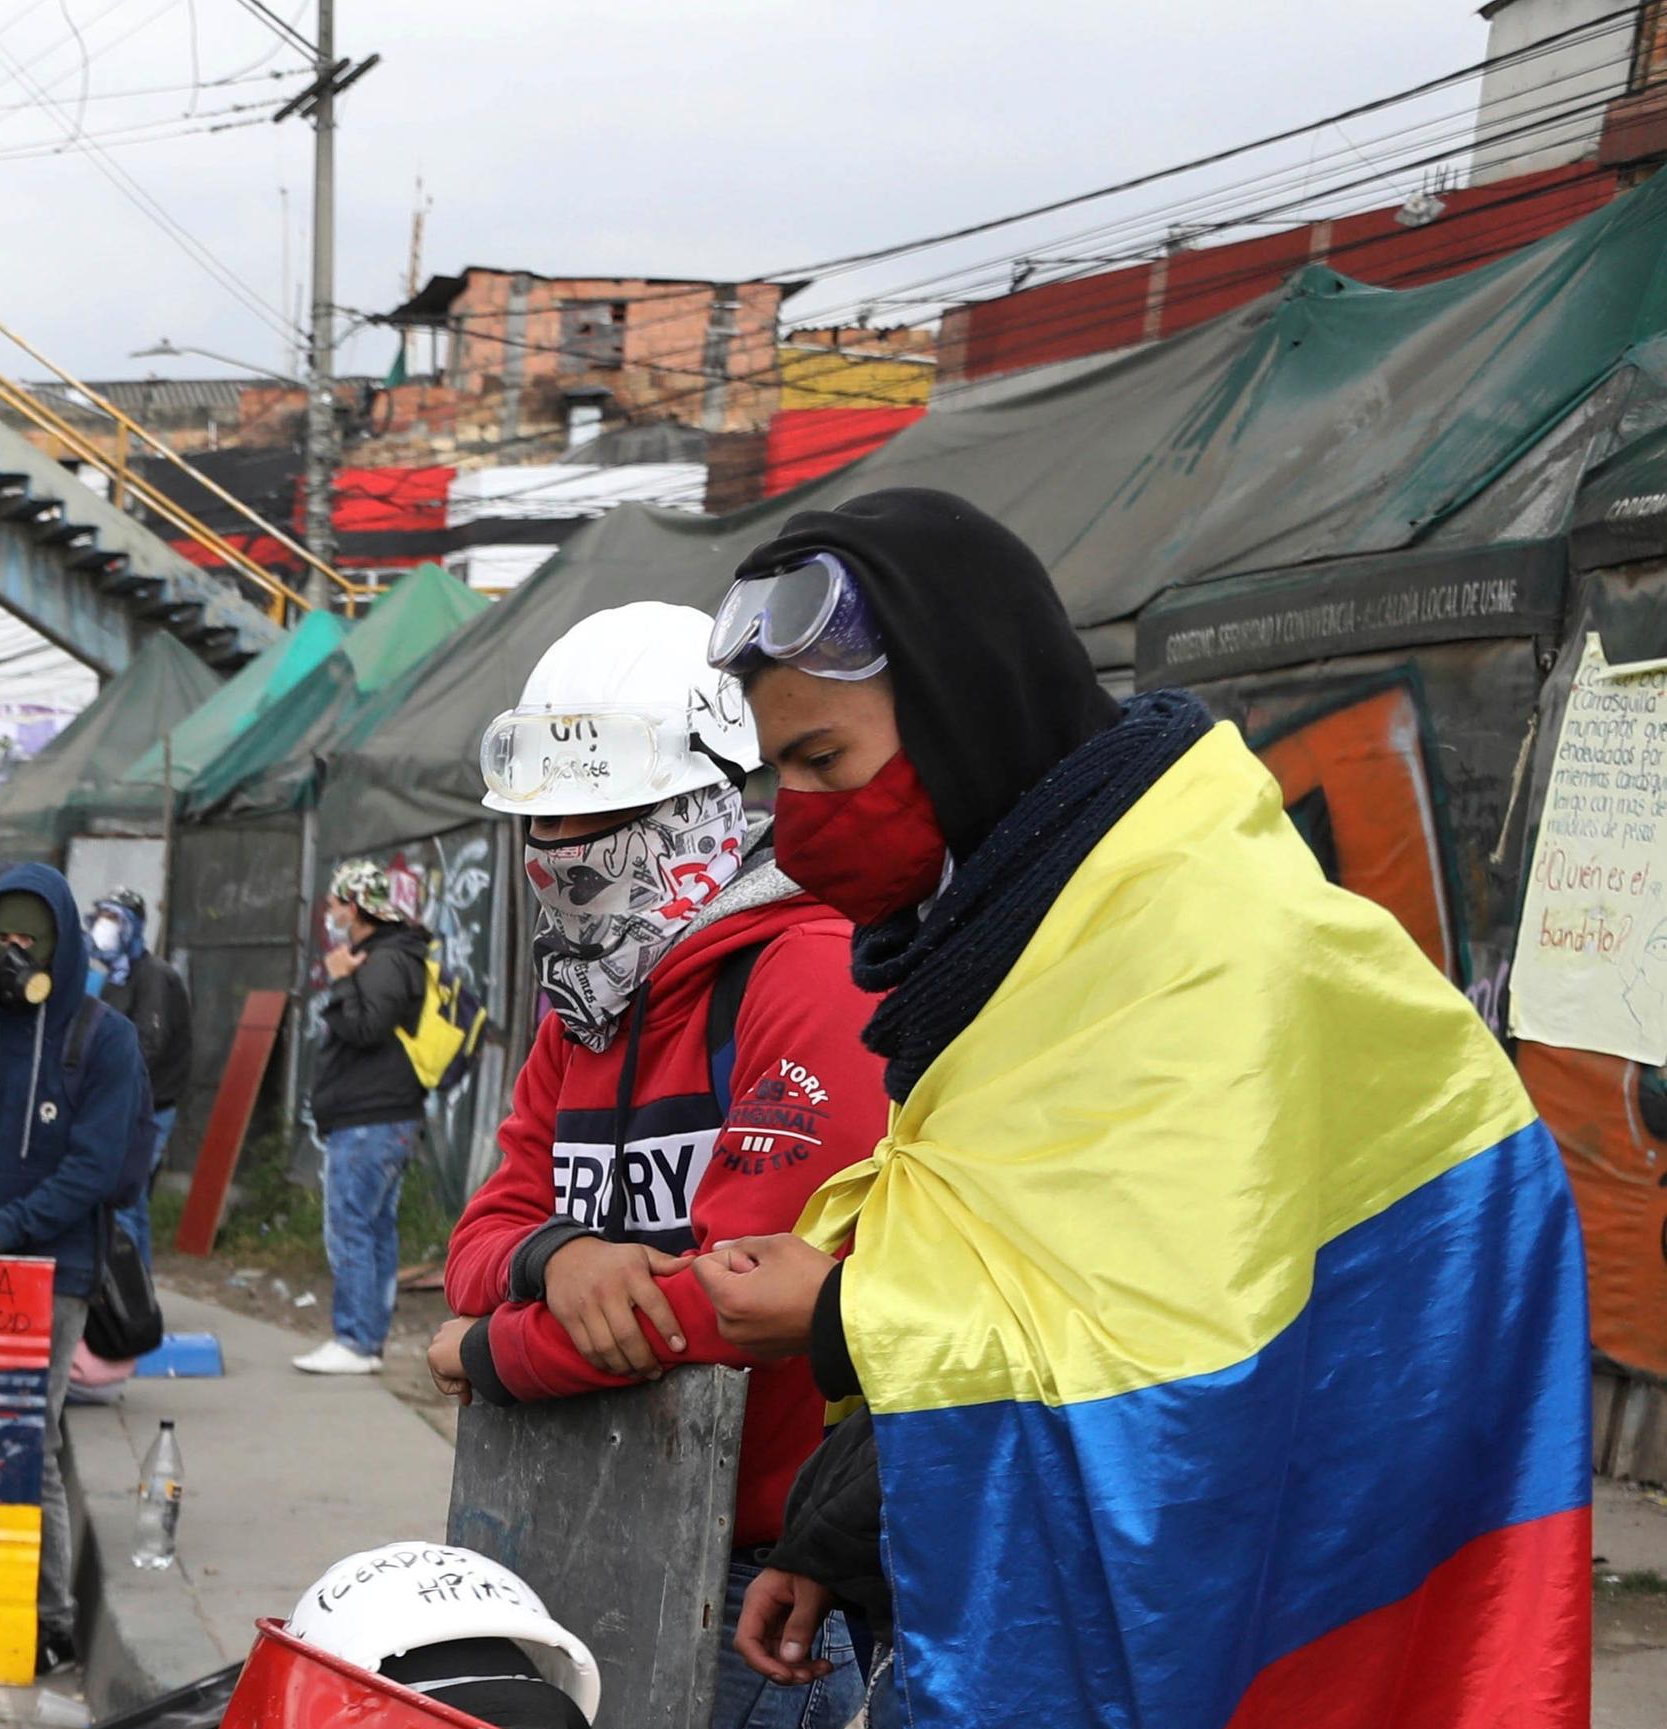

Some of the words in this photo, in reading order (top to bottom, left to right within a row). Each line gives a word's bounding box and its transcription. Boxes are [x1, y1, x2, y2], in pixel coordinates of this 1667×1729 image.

[1420, 586, 1458, 622] LOCAL
[1461, 582, 1480, 616] DE
[1480, 578, 1518, 614] USME
[1607, 866, 1625, 893] es
[1631, 860, 1652, 896] el
[778, 1057, 830, 1106] YORK
